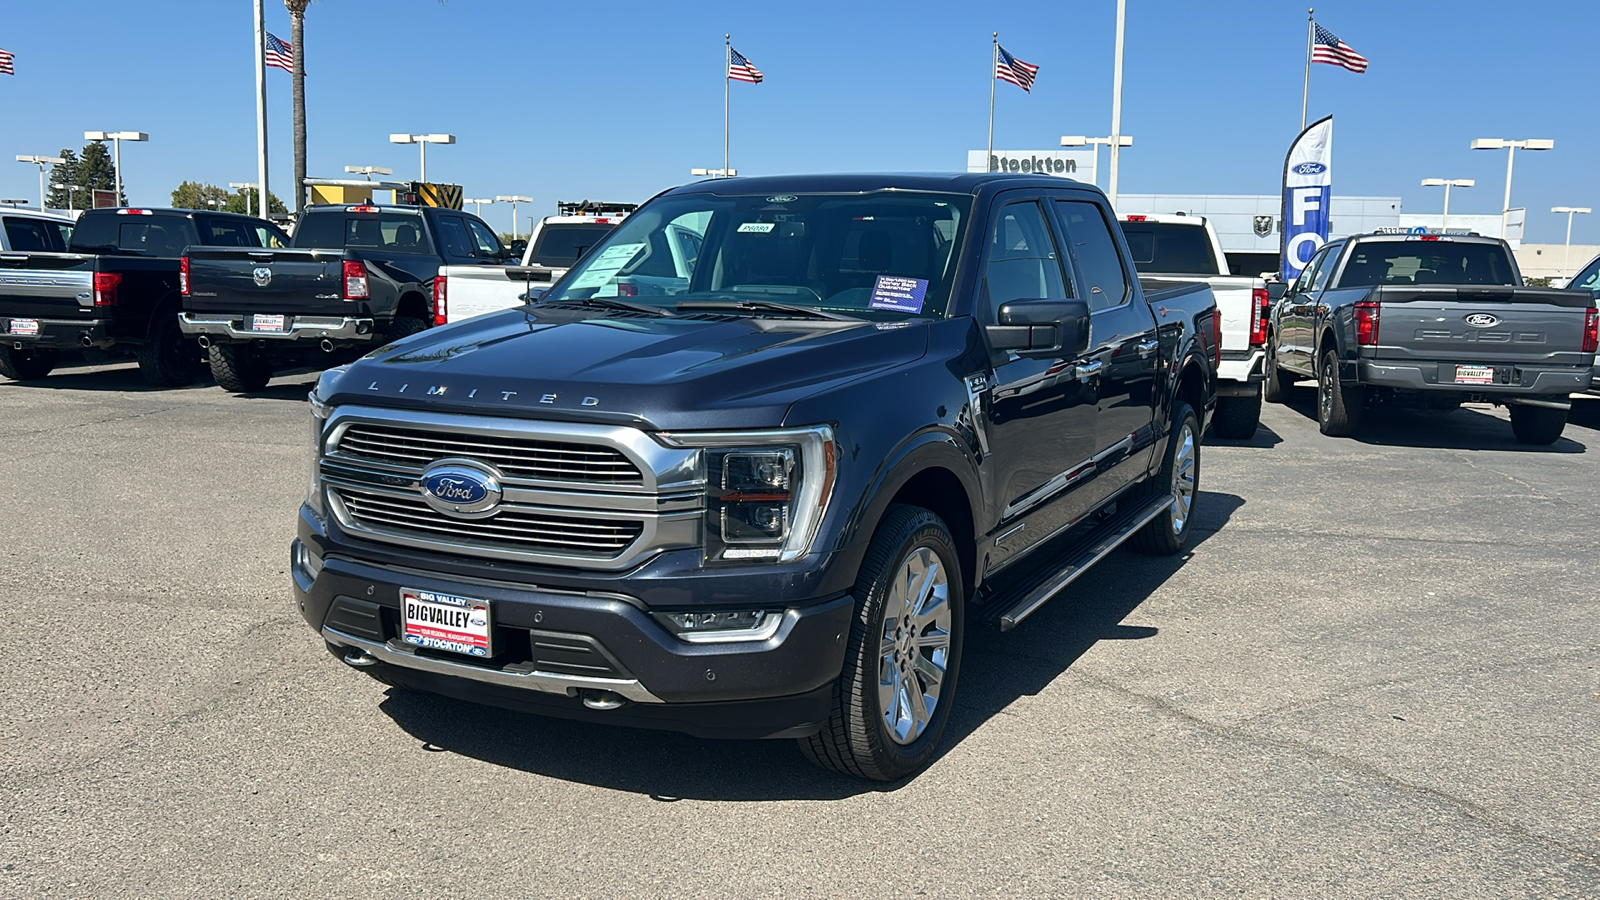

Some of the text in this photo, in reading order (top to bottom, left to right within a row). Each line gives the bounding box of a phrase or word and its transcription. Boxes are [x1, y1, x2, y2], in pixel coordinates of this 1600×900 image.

[990, 155, 1076, 173] Stockton
[1287, 188, 1325, 280] FO
[1414, 329, 1547, 344] F-150
[367, 381, 600, 408] LIMITED
[436, 477, 473, 499] Ford
[420, 592, 467, 606] BIG VALLEY
[407, 603, 470, 629] BIGVALLEY
[422, 637, 471, 653] STOCKTON
